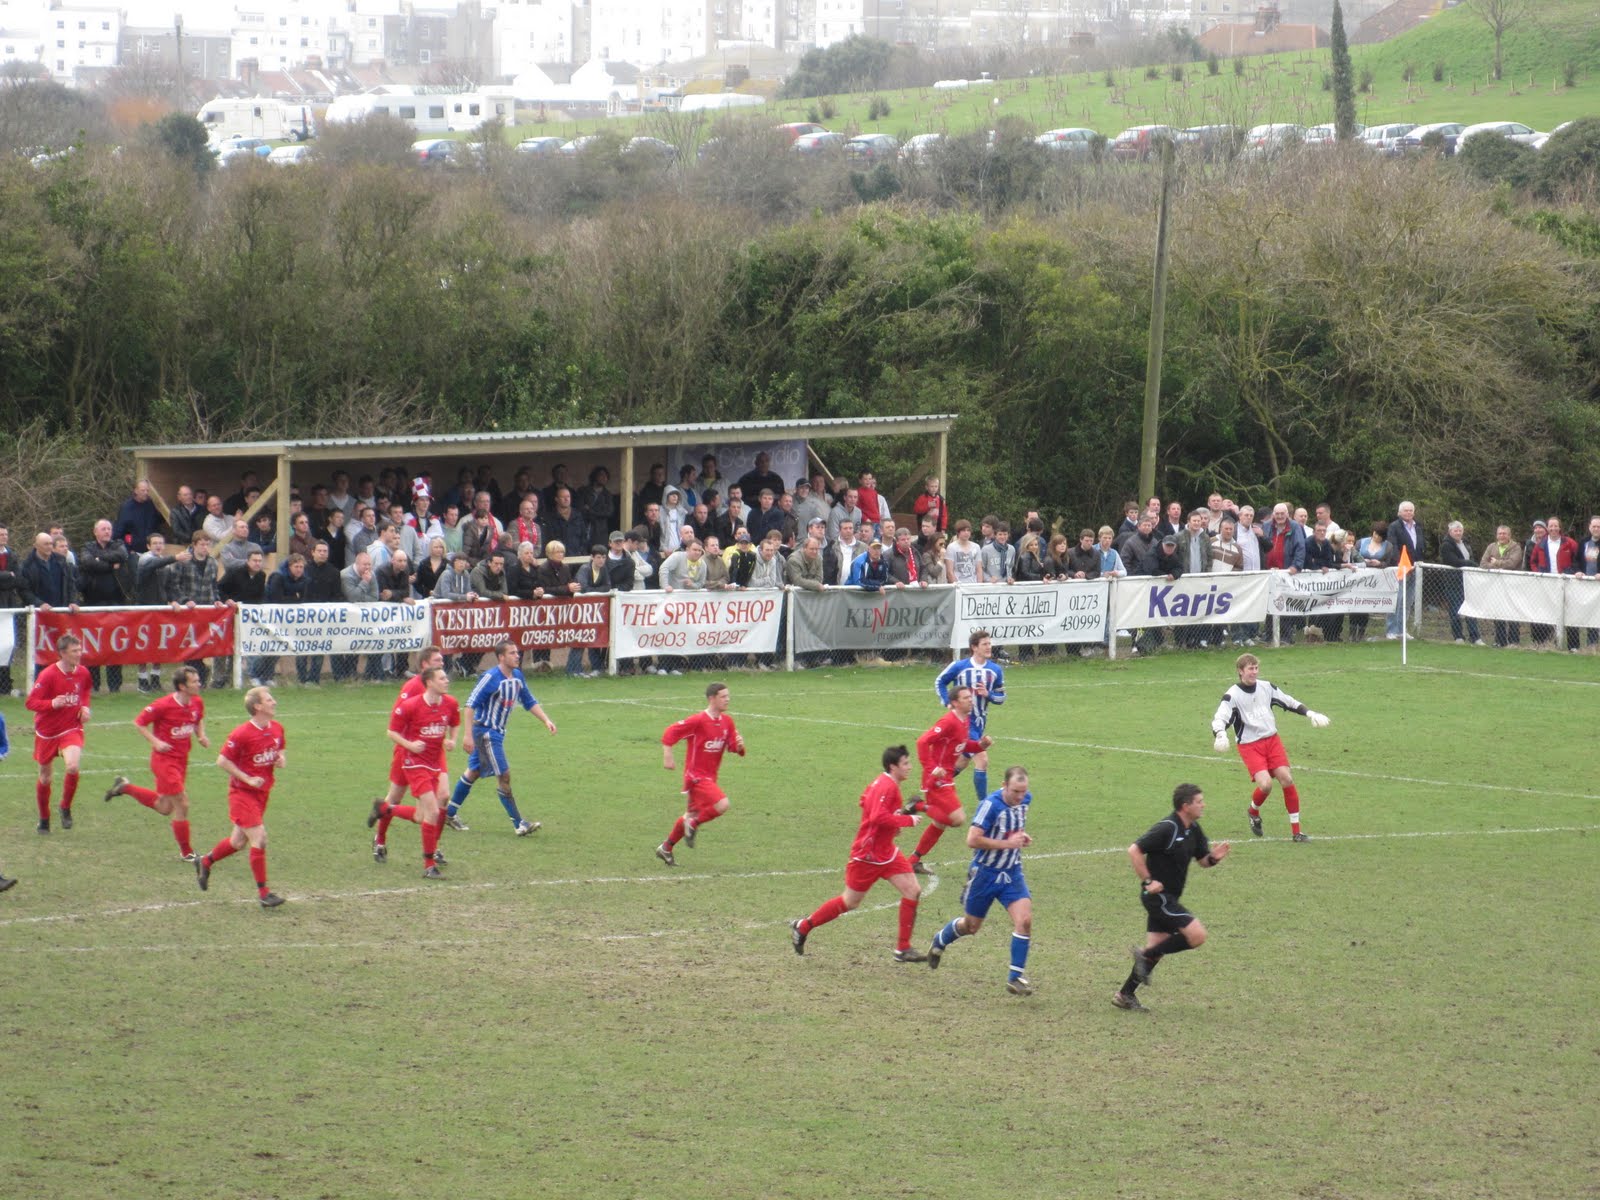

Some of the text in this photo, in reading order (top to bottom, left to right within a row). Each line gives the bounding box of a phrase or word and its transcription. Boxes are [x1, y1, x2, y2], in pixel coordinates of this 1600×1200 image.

[967, 595, 1050, 617] Deibel & Allen
[1069, 594, 1099, 611] 01273
[1148, 585, 1234, 618] Karis
[241, 605, 425, 624] BOLINGBROKE ROOFING
[435, 602, 605, 631] KESTREL BRICKWORK
[621, 599, 774, 626] THE SPRAY SHOP
[845, 600, 949, 633] KENDRICK
[1060, 614, 1101, 631] 430999
[37, 618, 229, 654] KNGSPAN
[250, 625, 412, 636] FOR ALL YOUR ROOFING WORKS
[440, 634, 469, 649] 01273
[521, 630, 555, 646] 07956
[557, 628, 596, 644] 313423
[638, 629, 748, 649] 01903 851297
[259, 641, 289, 653] 01273
[293, 640, 333, 653] 303848
[350, 639, 384, 651] 07778
[387, 637, 425, 650] 578351
